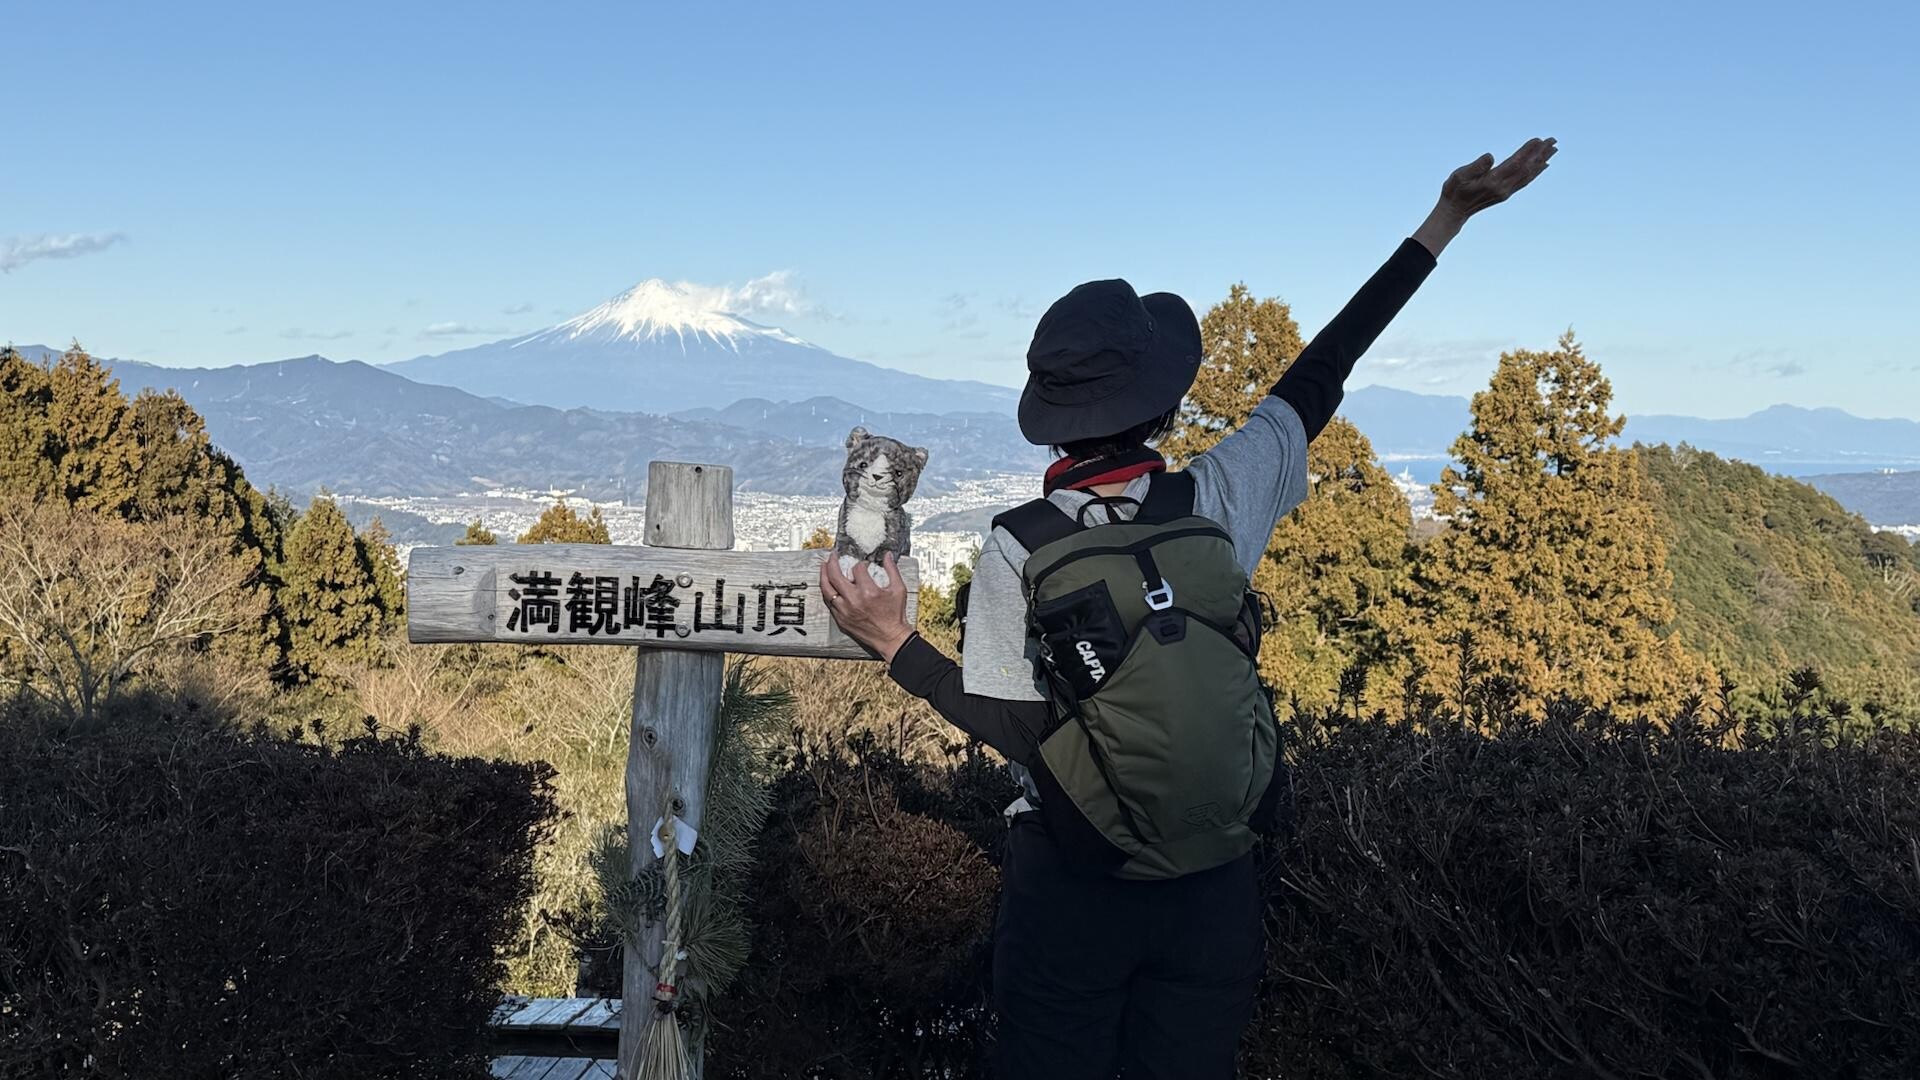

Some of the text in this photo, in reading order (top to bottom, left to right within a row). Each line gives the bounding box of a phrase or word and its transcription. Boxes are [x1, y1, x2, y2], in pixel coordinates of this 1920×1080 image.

[507, 571, 808, 638] 満観峰山頂
